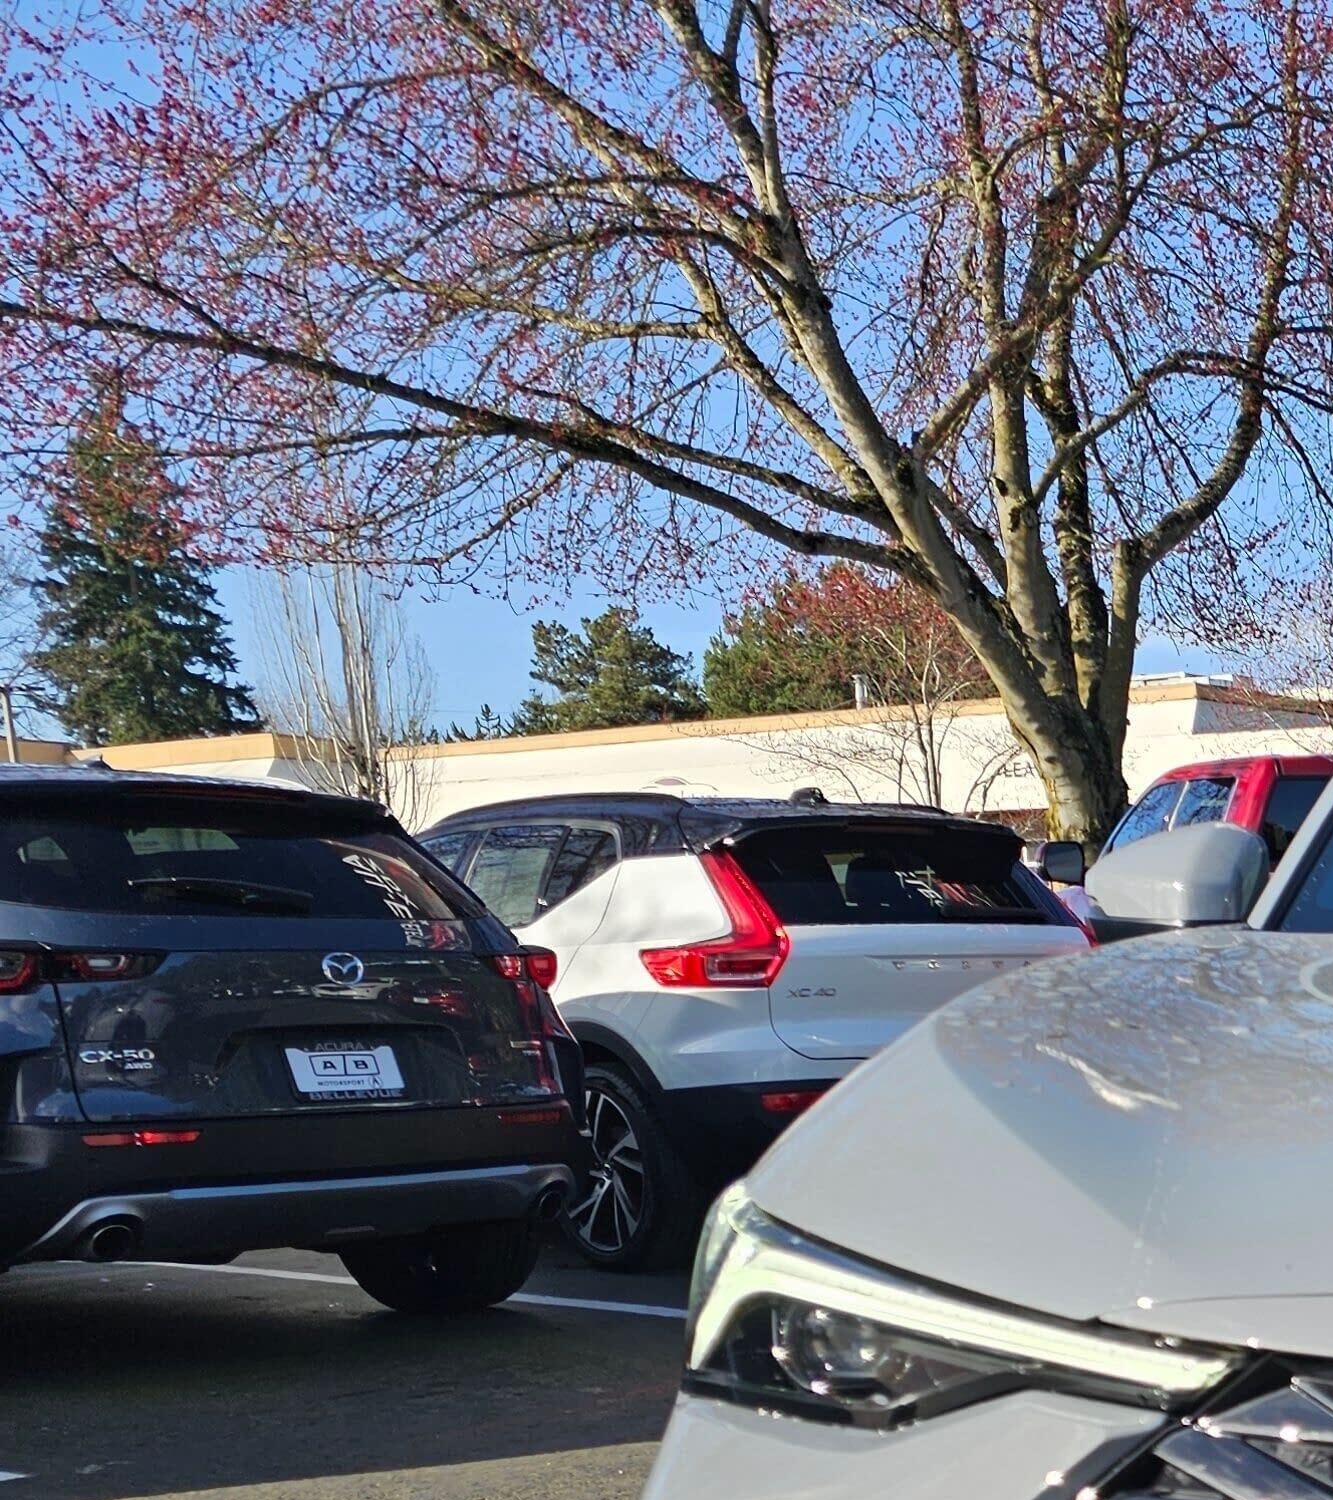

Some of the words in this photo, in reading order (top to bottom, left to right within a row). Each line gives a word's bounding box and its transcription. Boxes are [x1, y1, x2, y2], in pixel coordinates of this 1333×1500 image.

[787, 987, 837, 999] XC40
[315, 1041, 365, 1052] ACURA
[80, 1048, 155, 1064] CX-50
[317, 1079, 365, 1087] MOTORSPORT
[309, 1088, 402, 1101] BELLEVUE
